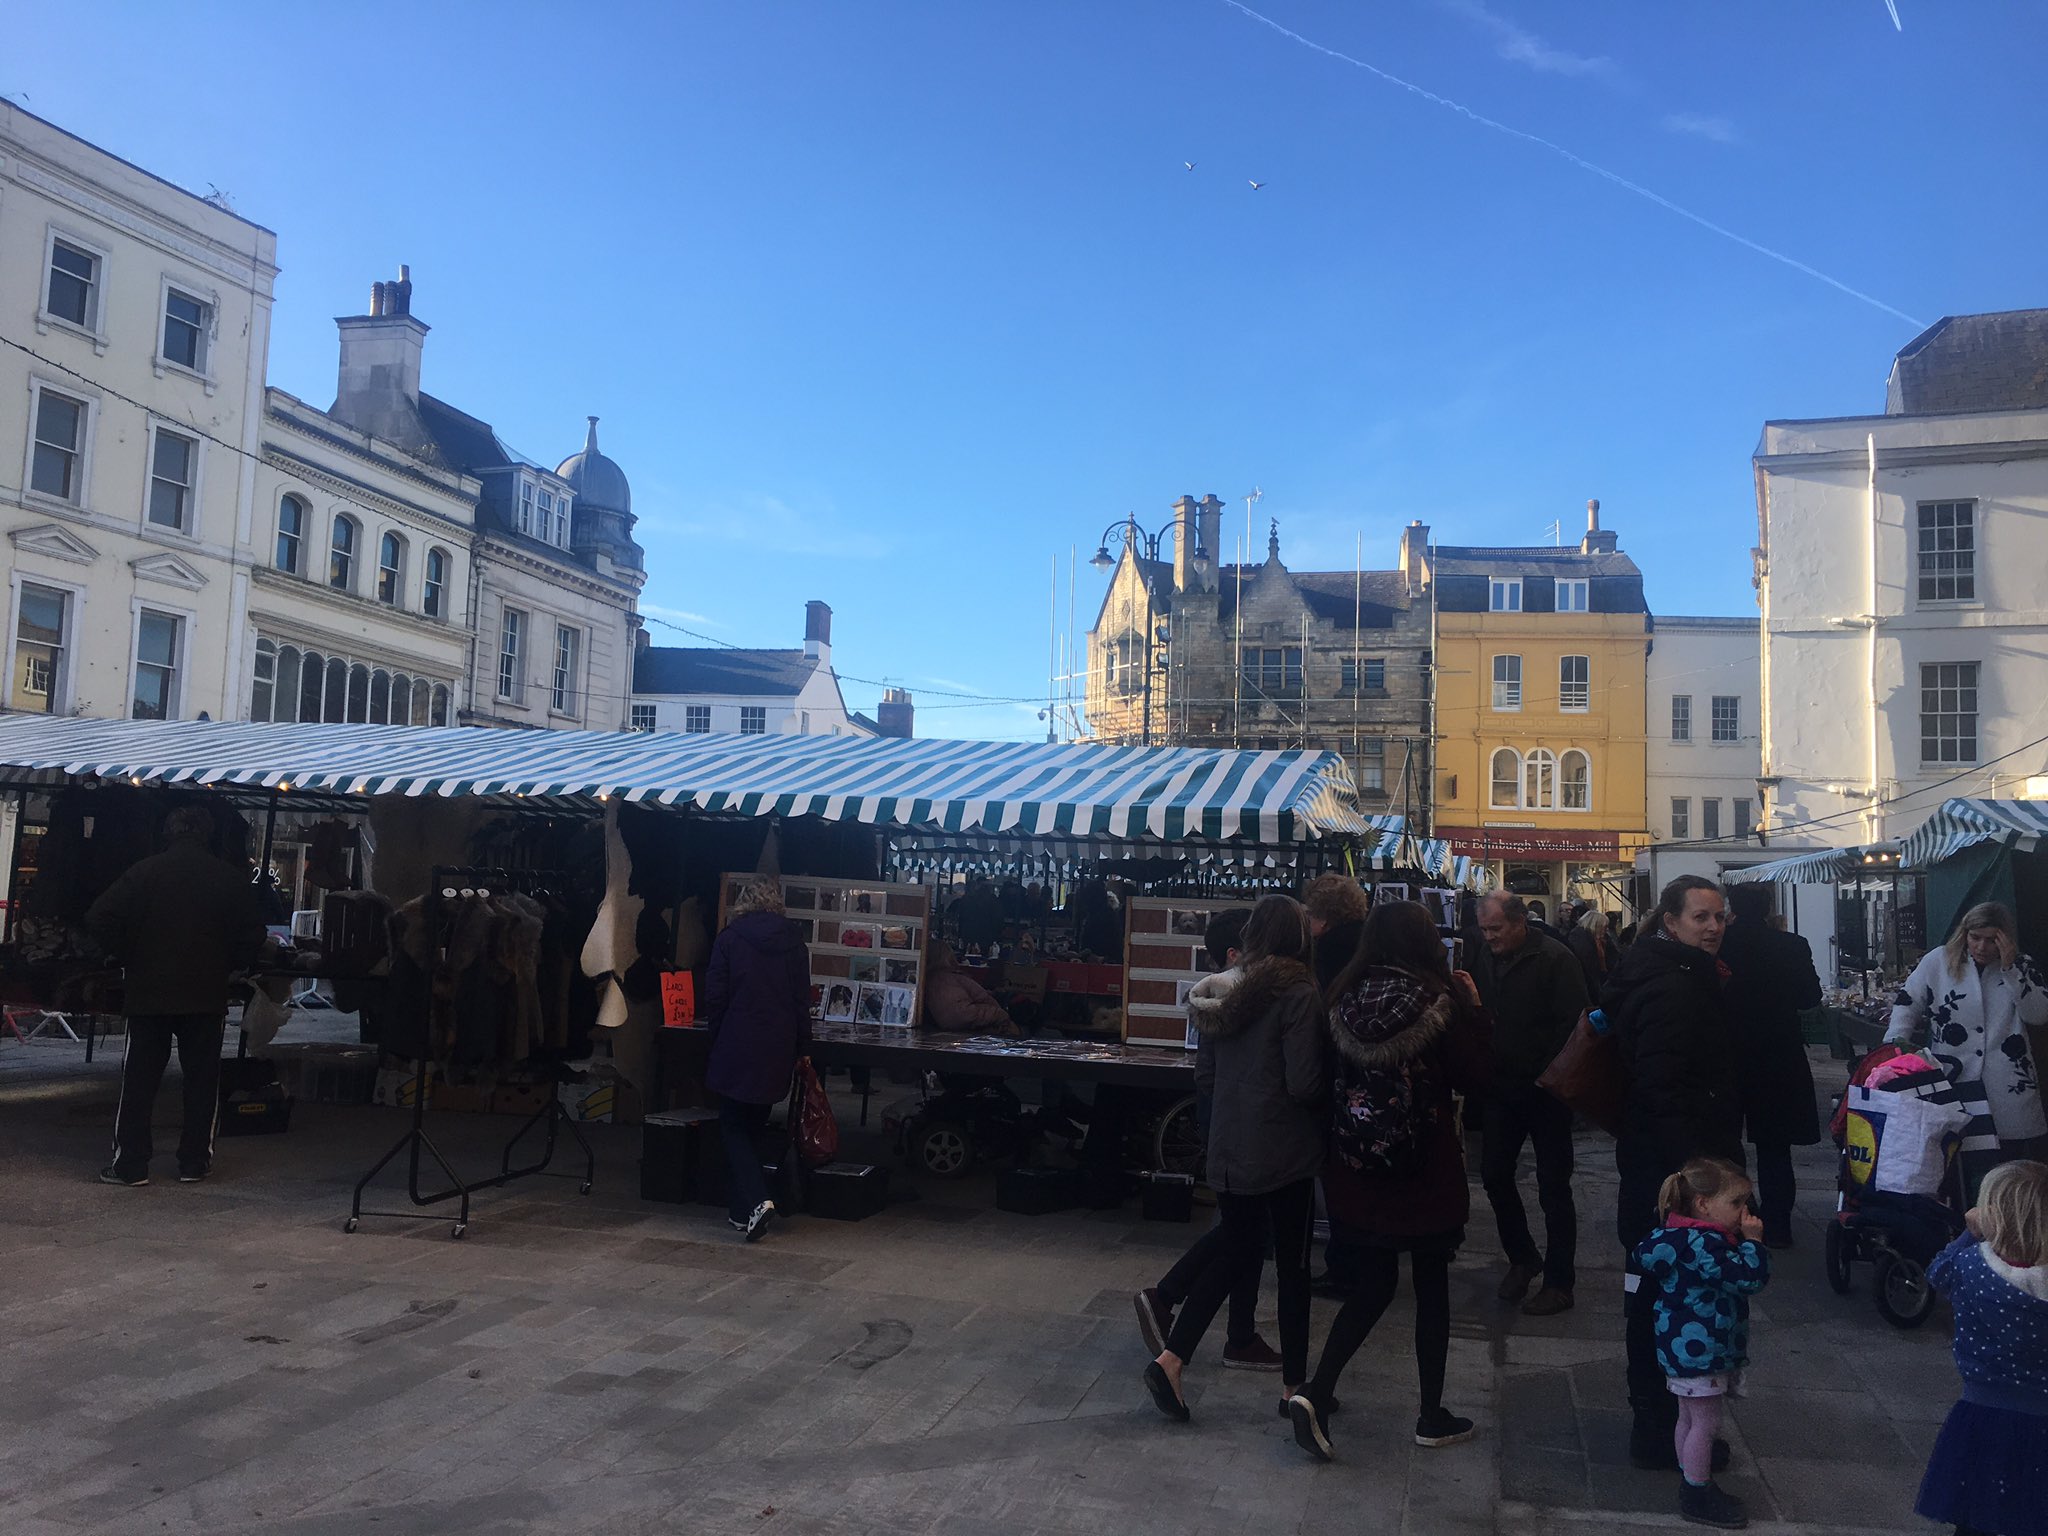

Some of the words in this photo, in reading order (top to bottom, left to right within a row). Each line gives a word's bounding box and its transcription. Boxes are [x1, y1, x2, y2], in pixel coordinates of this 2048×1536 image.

[1472, 838, 1532, 854] Edinburgh
[1536, 839, 1583, 852] Woollen
[1588, 840, 1612, 852] Mill
